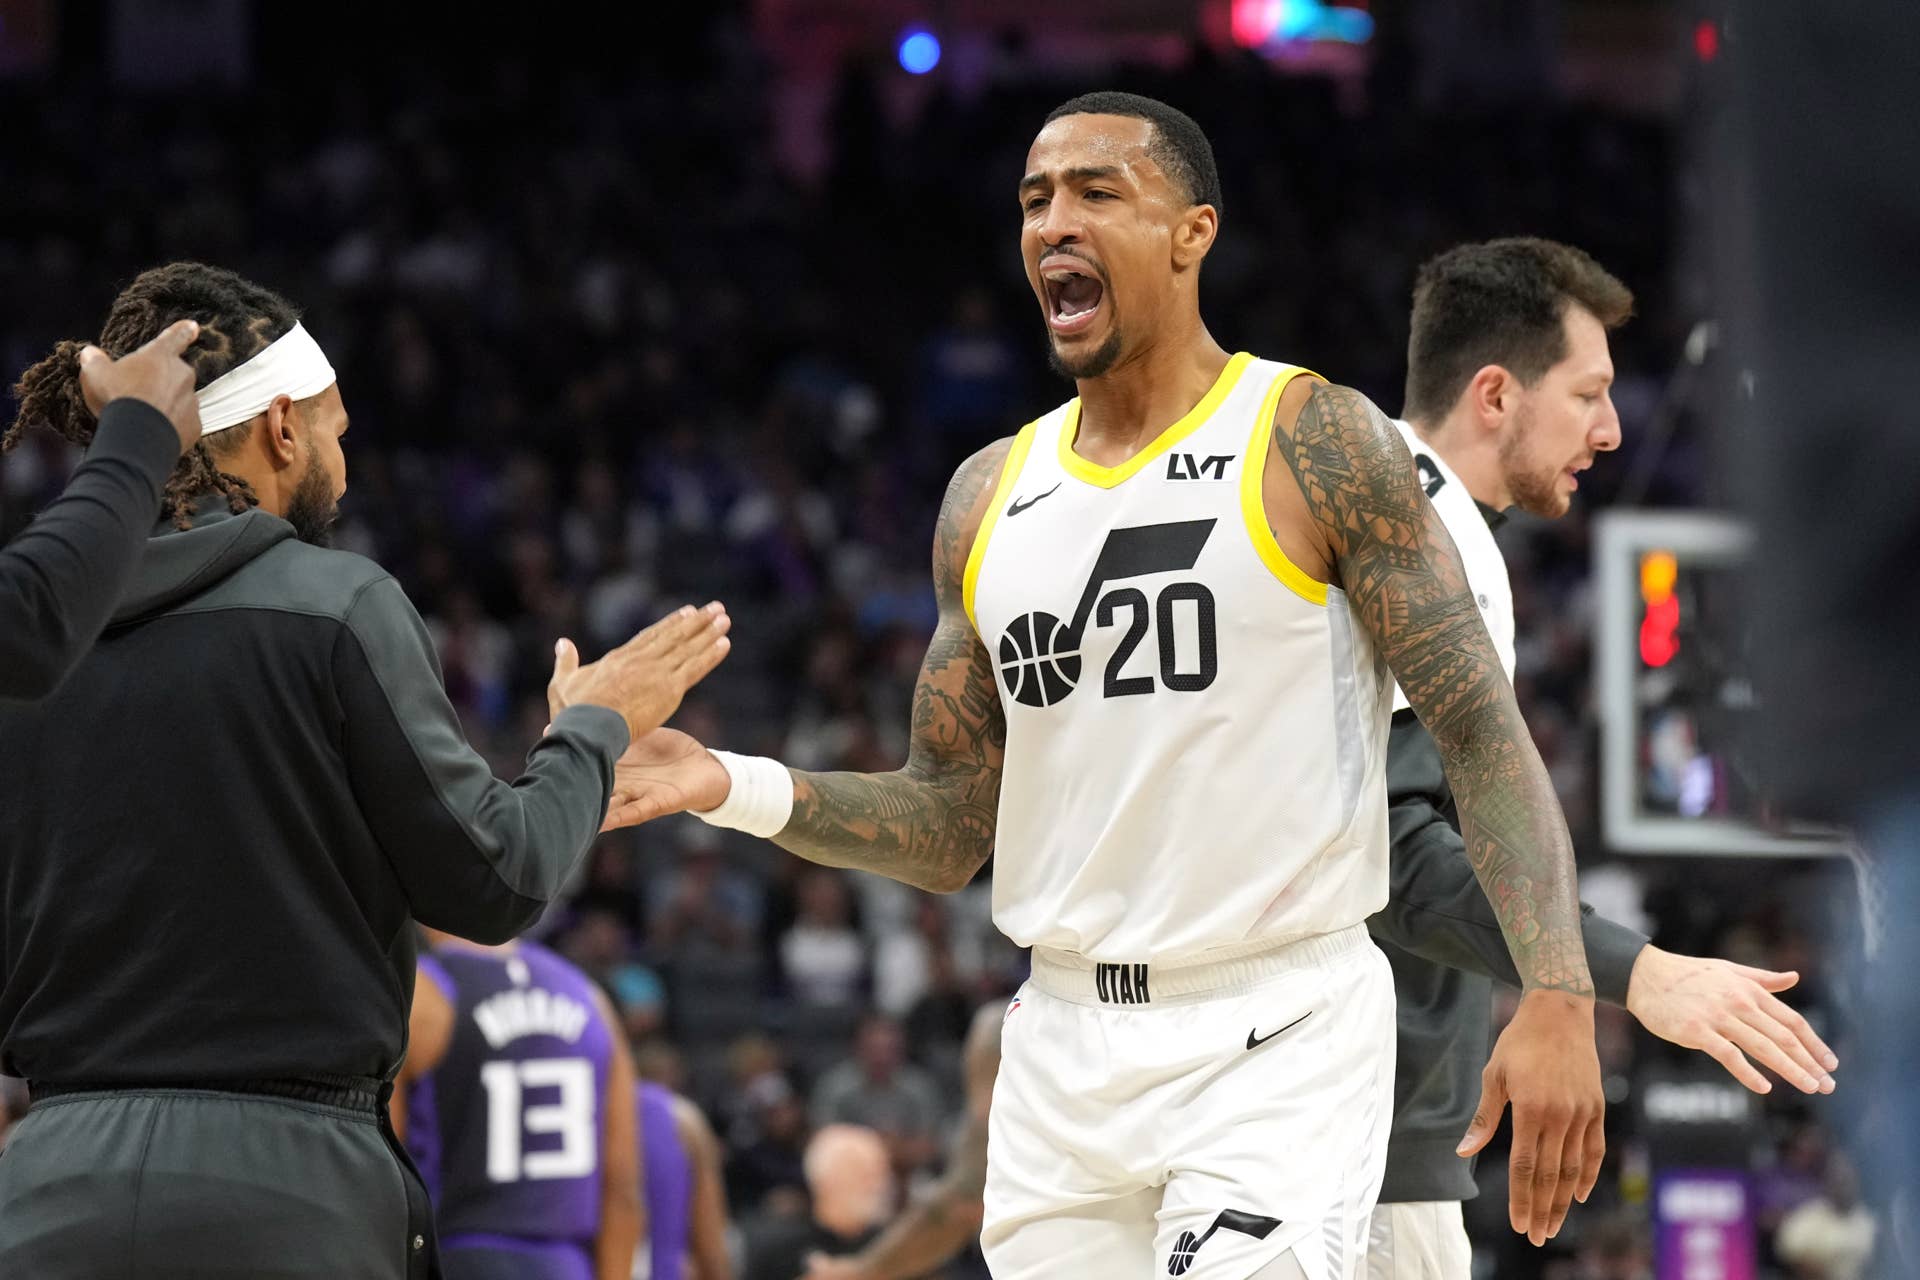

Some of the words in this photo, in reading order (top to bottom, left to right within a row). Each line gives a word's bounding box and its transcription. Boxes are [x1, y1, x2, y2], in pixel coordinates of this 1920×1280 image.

[1166, 453, 1236, 480] LVT
[1096, 582, 1218, 698] 20
[1095, 962, 1151, 1005] UTAH
[481, 1056, 598, 1182] 13
